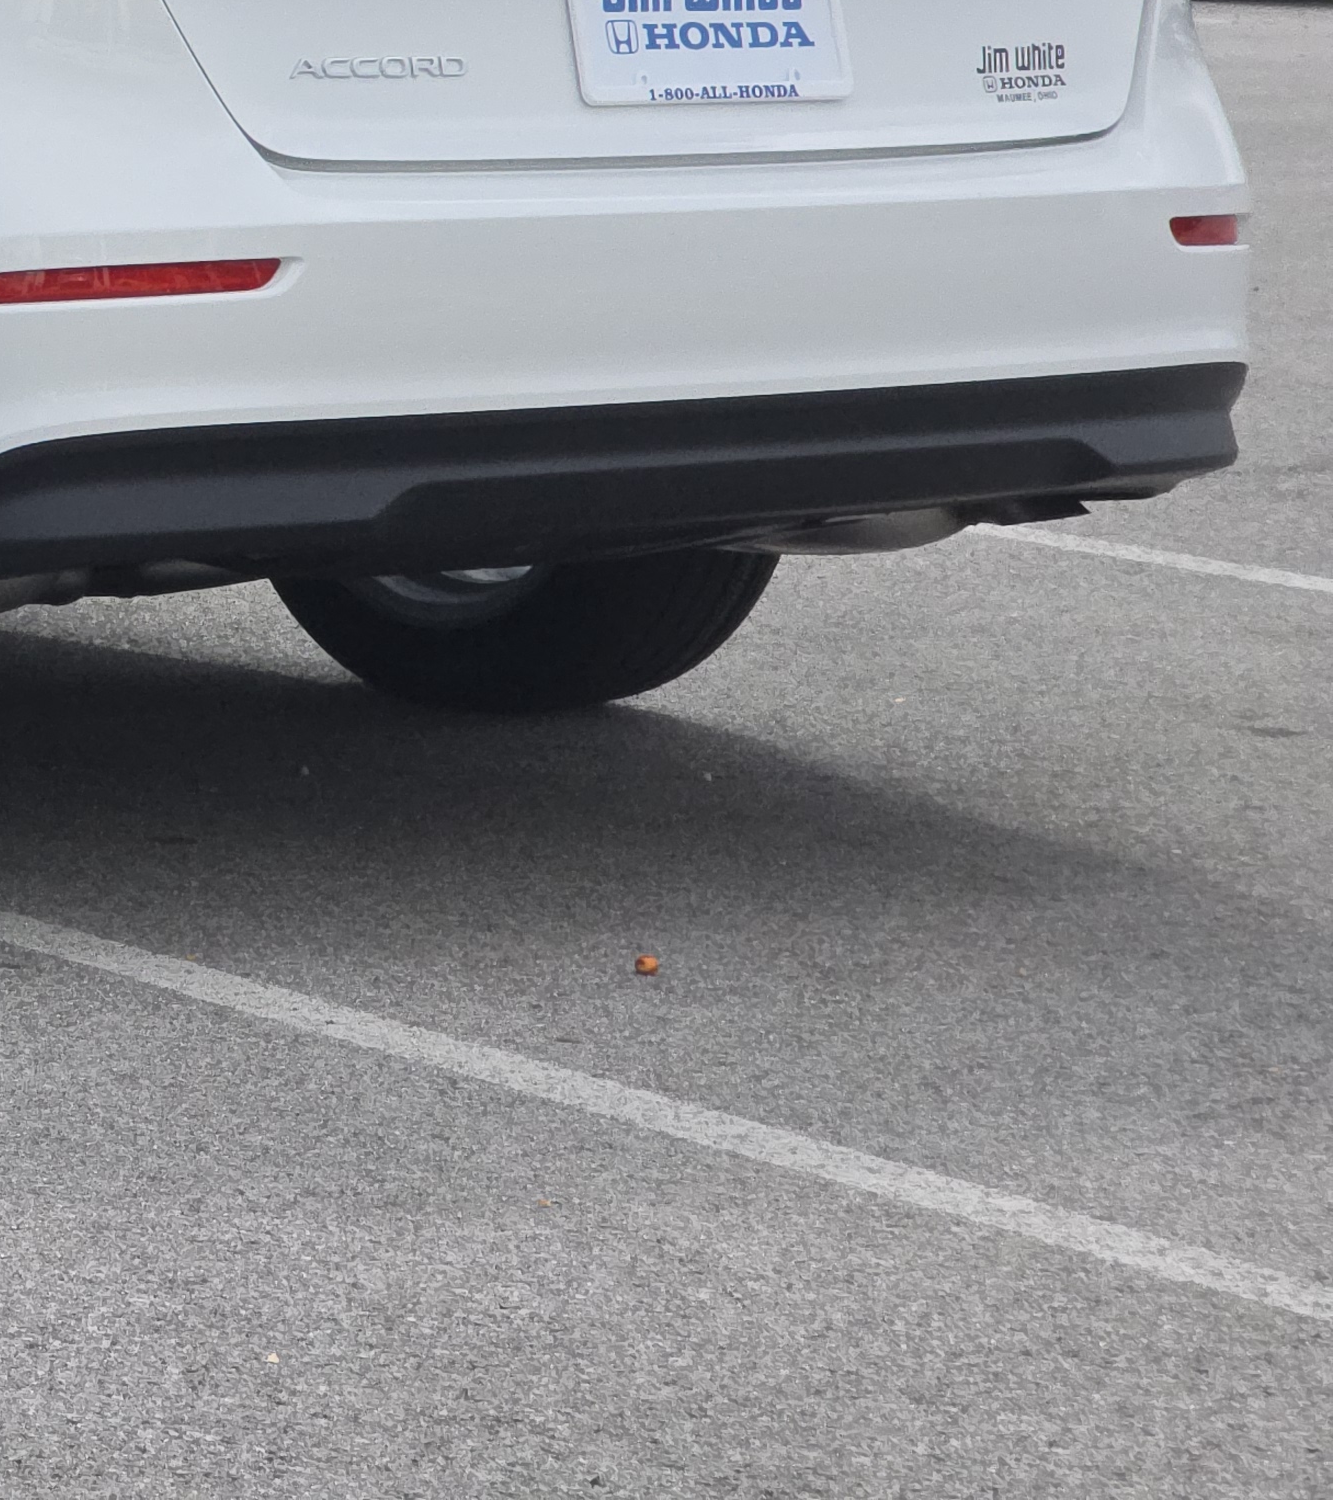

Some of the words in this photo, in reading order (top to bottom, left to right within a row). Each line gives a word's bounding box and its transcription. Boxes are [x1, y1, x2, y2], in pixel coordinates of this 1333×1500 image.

[642, 21, 815, 50] HONDA
[289, 56, 468, 79] ACCORD
[976, 45, 1010, 74] Jim
[1000, 74, 1066, 90] HONDA
[649, 84, 800, 101] 1-800-ALL-HONDA
[1038, 91, 1058, 102] OHIO
